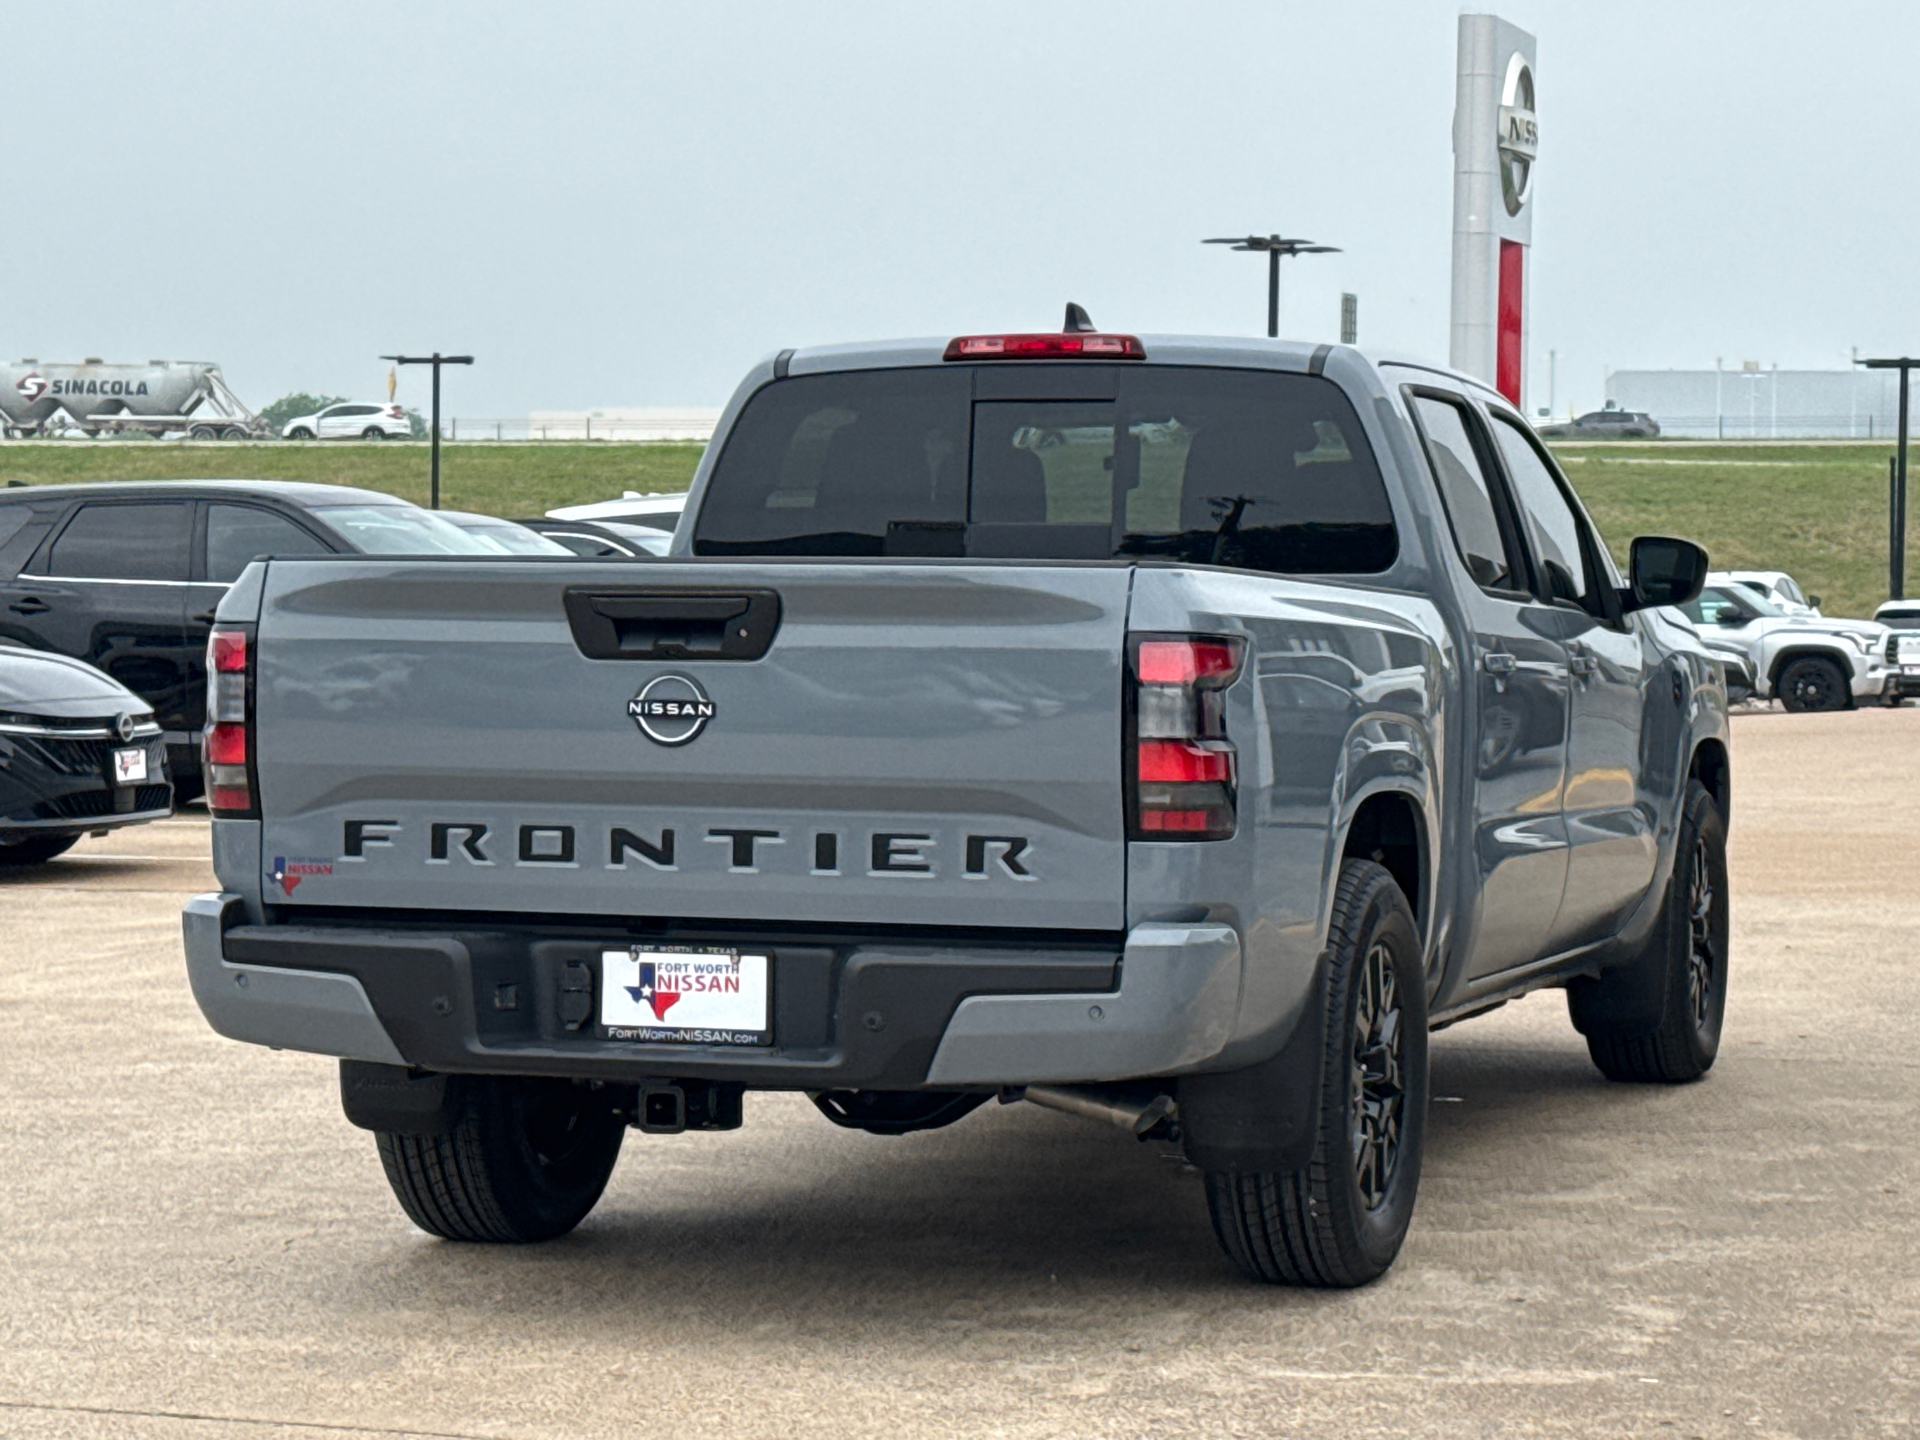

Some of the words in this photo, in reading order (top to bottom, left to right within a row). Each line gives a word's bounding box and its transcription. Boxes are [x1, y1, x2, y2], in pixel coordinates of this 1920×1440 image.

[1509, 115, 1538, 146] NISS
[51, 379, 149, 396] SINACOLA
[629, 701, 712, 716] NISSAN
[337, 819, 1038, 882] FRONTIER
[287, 864, 333, 875] NISSAN
[657, 962, 690, 973] FORT
[693, 963, 740, 974] WORTH
[657, 974, 740, 993] NISSAN
